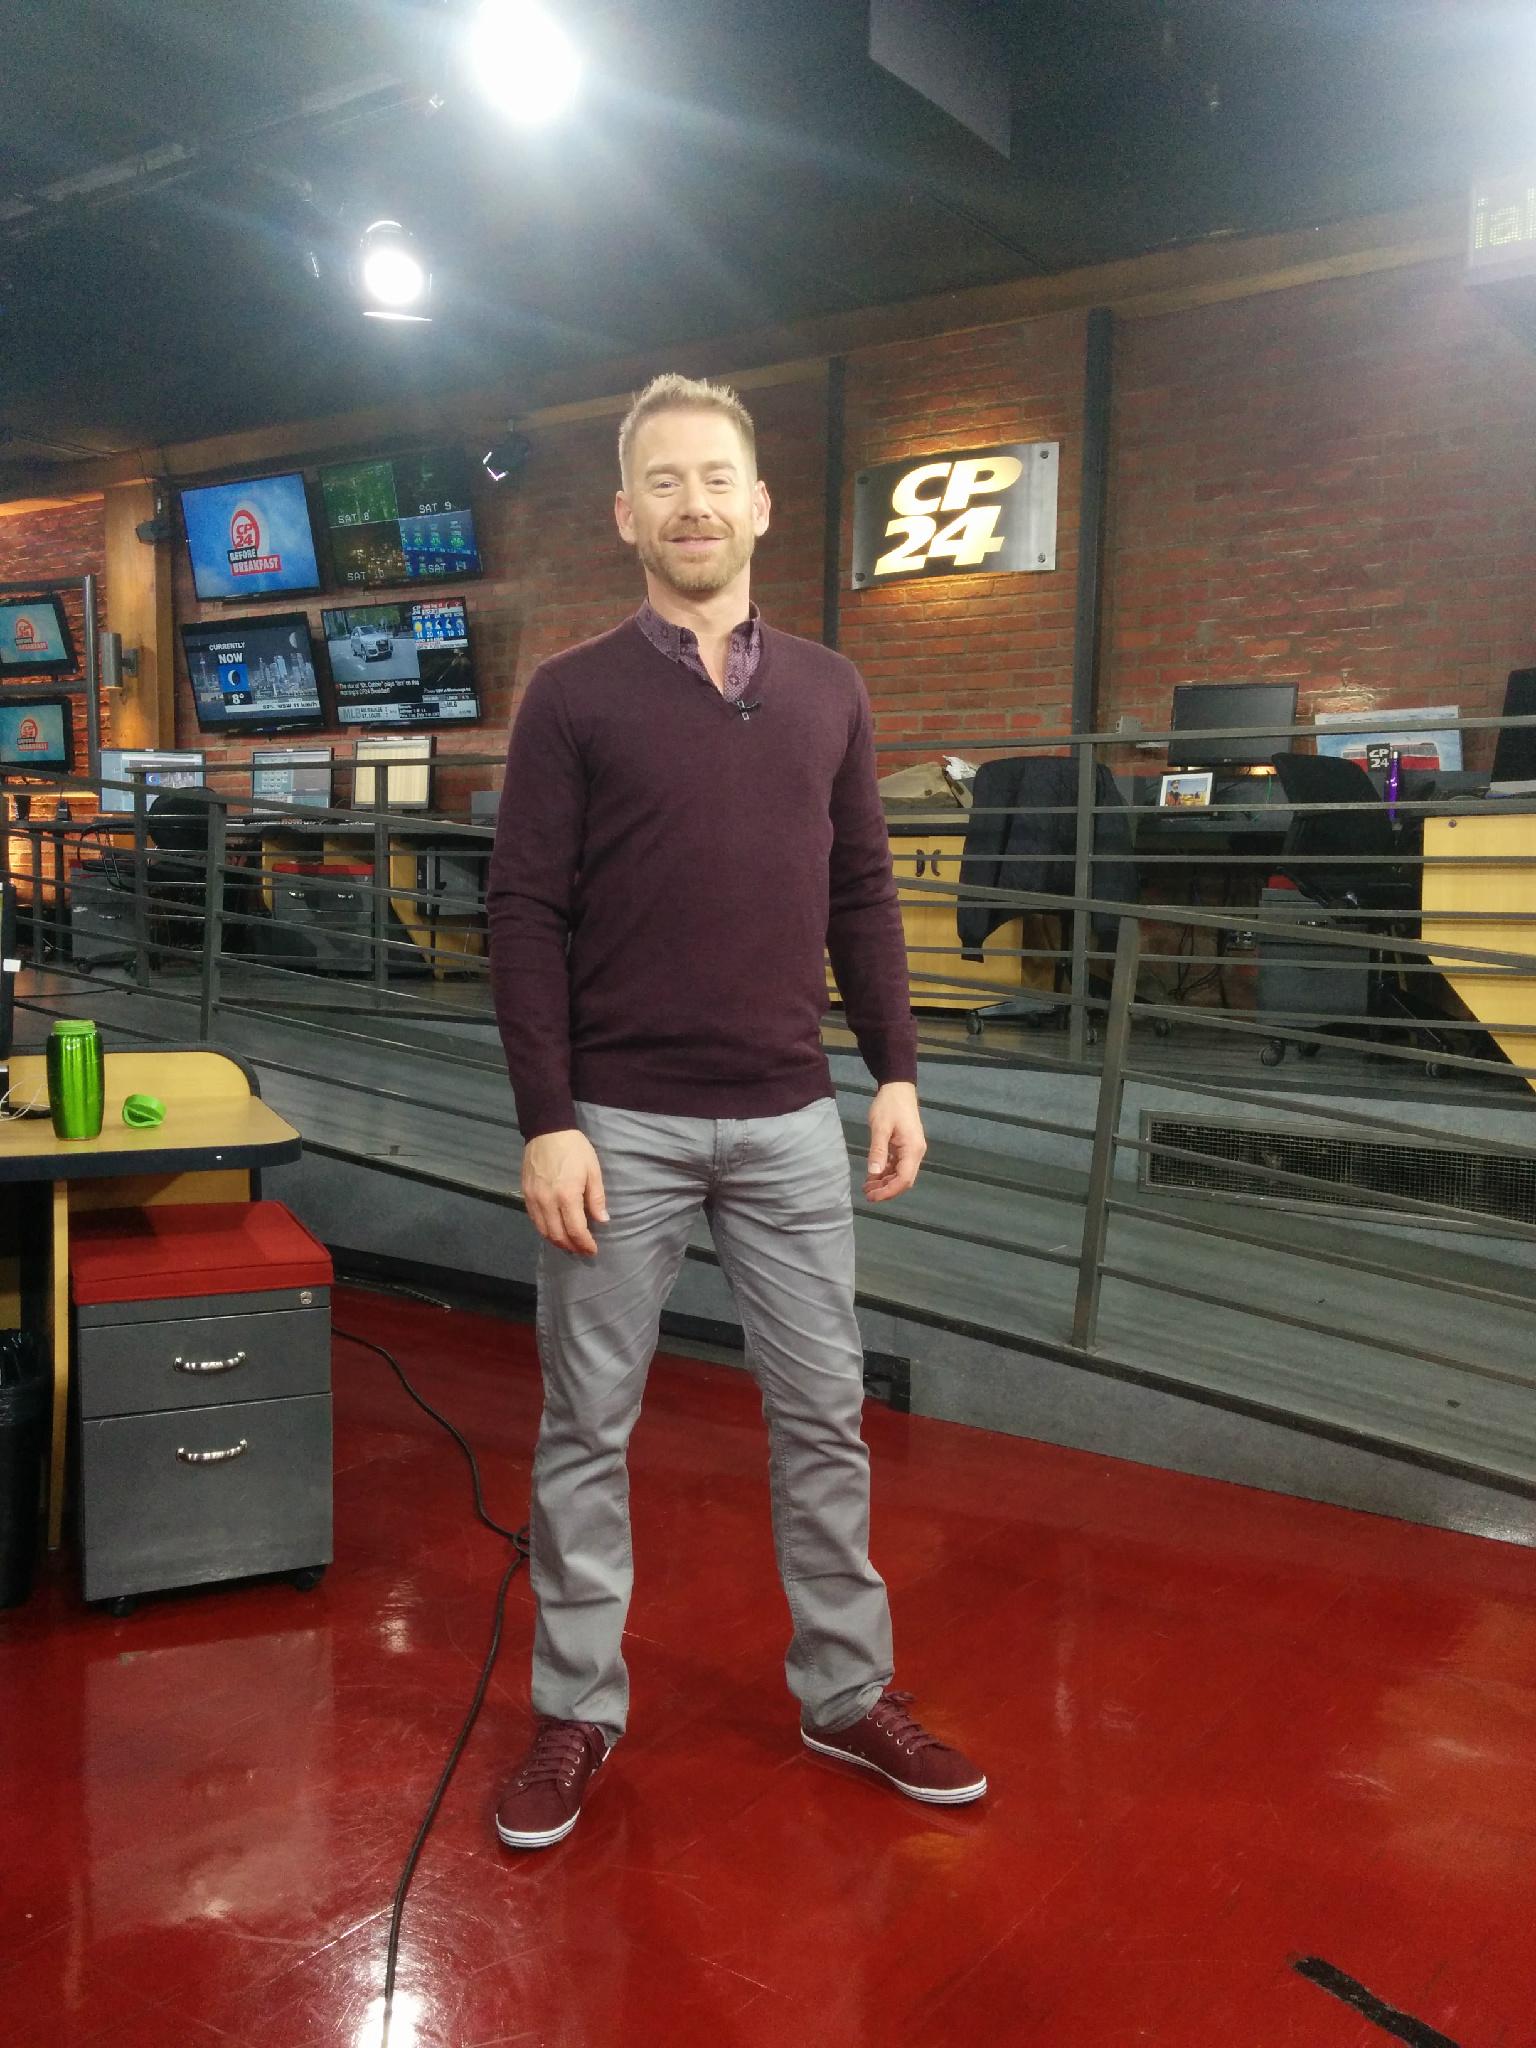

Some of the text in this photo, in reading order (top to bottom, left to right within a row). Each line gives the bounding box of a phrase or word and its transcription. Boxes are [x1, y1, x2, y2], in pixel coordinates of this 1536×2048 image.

[892, 456, 1023, 516] CP
[419, 500, 452, 514] SAT 9
[338, 512, 370, 524] SAT 8
[236, 523, 253, 535] CP
[236, 534, 253, 547] 24
[874, 505, 1005, 576] 24
[230, 548, 256, 561] BEFORE
[233, 557, 278, 572] BREAKFAST
[428, 562, 447, 573] SAT
[347, 571, 366, 581] SAT
[209, 642, 245, 651] CURRENTLY
[218, 652, 243, 664] NOW
[231, 693, 244, 704] 8°
[1369, 749, 1390, 758] CP
[1370, 758, 1390, 768] 24
